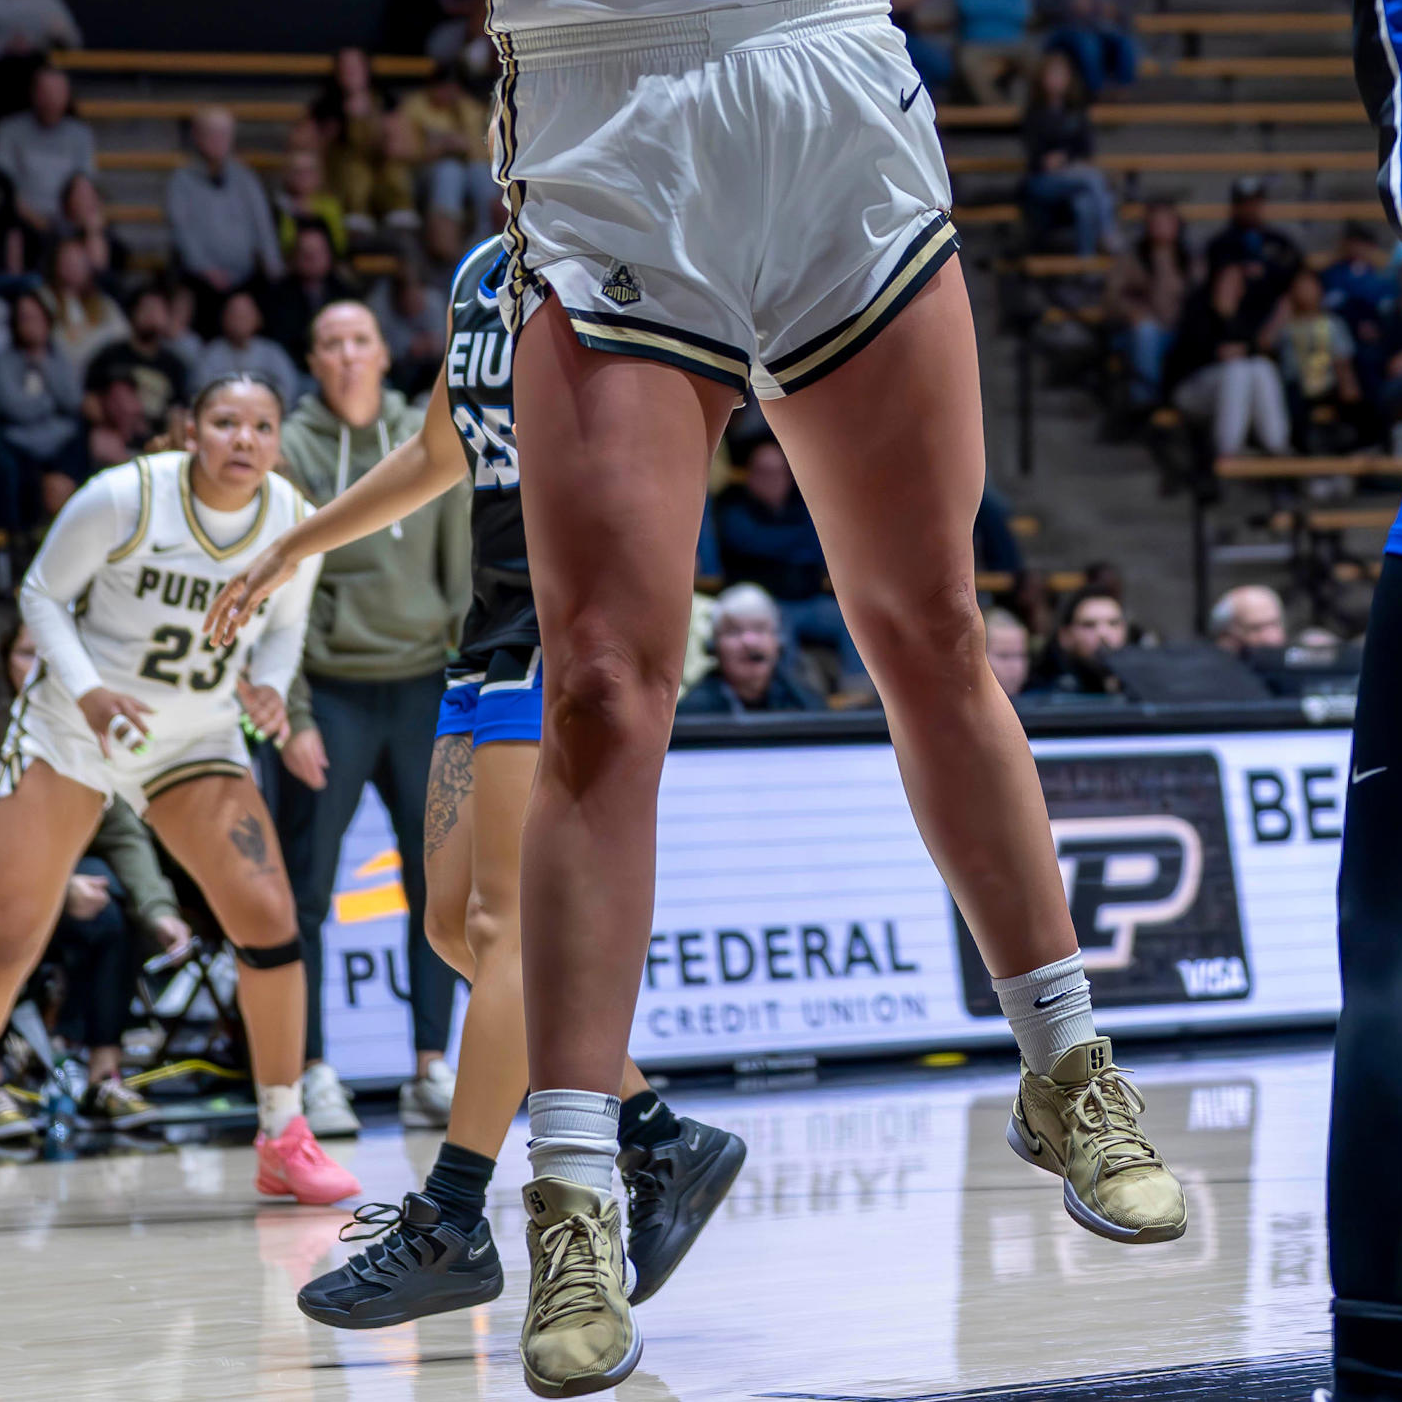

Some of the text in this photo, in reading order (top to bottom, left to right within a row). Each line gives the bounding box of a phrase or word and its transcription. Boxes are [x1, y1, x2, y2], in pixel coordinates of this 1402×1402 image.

[448, 331, 513, 388] EIU
[452, 404, 520, 490] 25
[135, 564, 271, 616] PUR
[137, 623, 239, 692] 23
[1244, 765, 1342, 844] BE
[645, 919, 917, 989] FEDERAL
[1175, 957, 1251, 999] VISA
[647, 995, 927, 1037] CREDIT UNION
